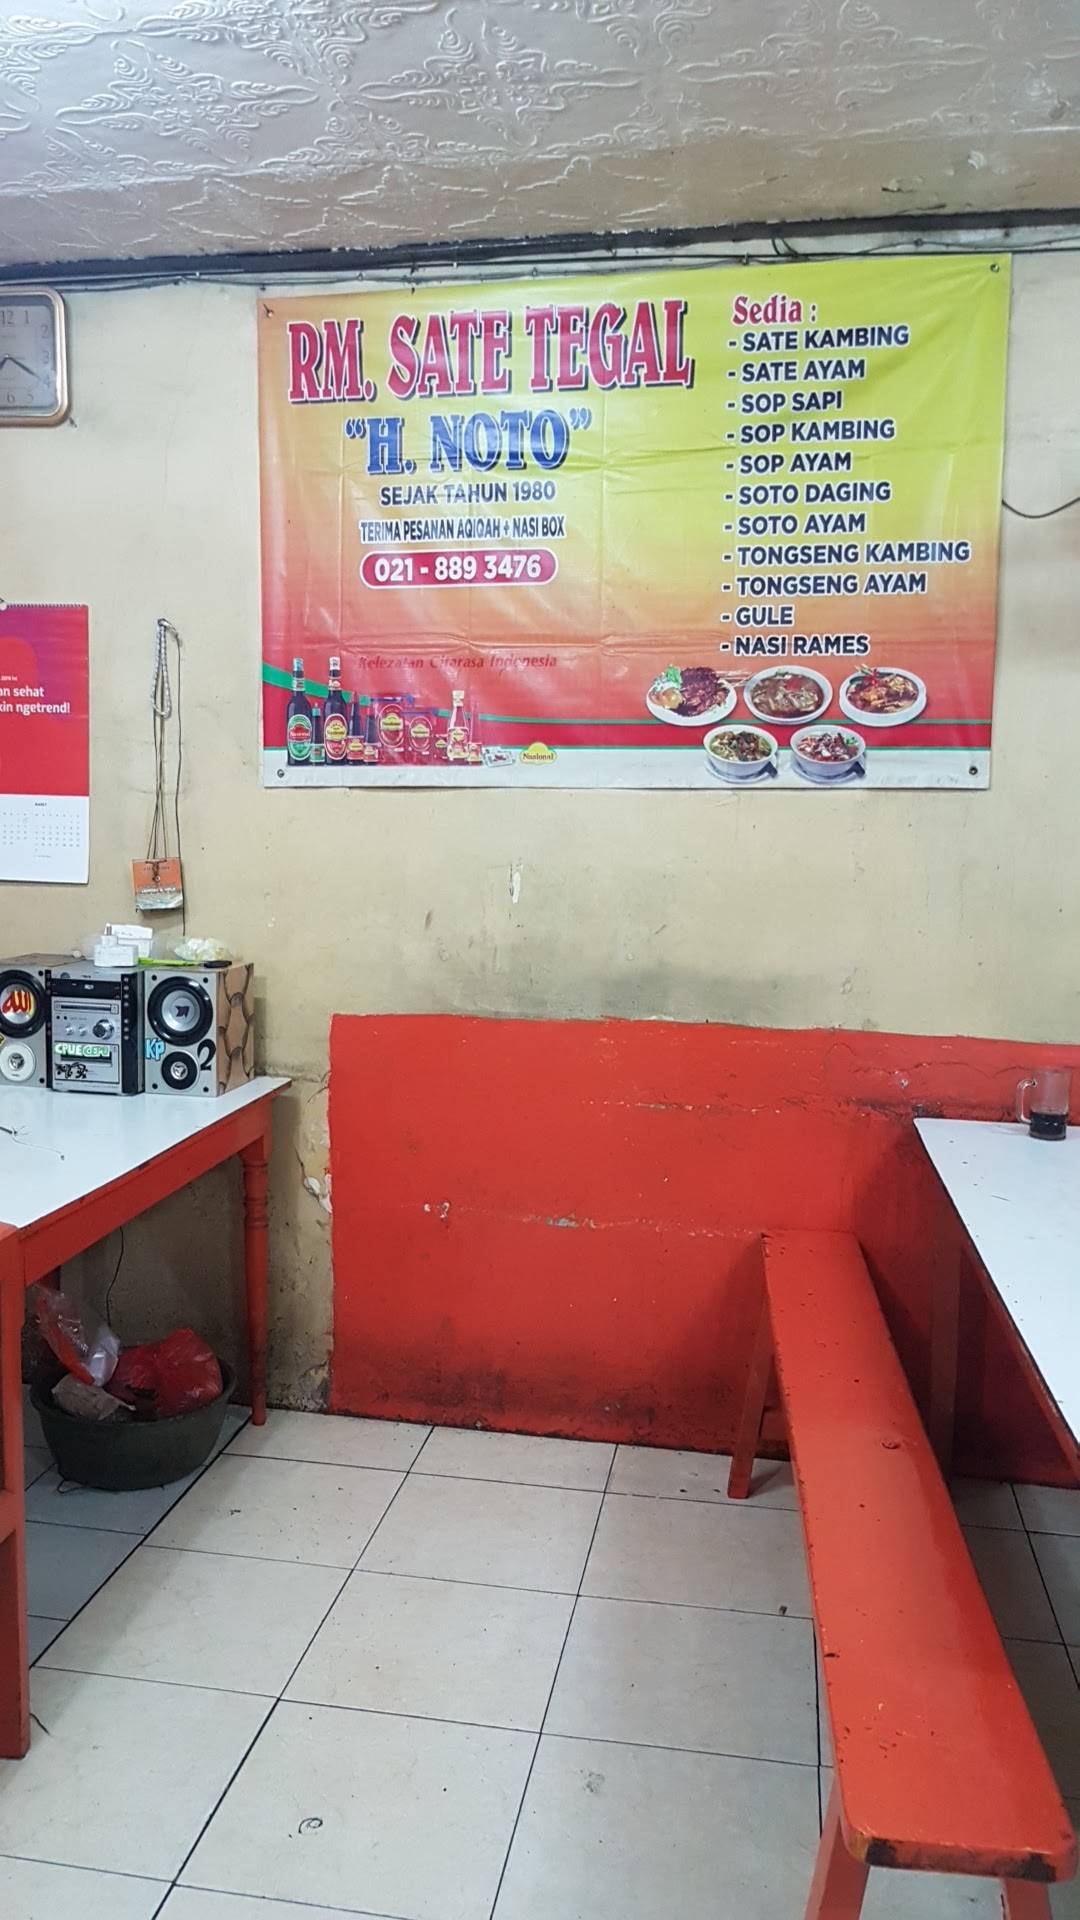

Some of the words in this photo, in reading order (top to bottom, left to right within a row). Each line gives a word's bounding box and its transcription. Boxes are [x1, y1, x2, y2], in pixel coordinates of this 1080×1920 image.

[733, 295, 802, 324] Sedia
[742, 332, 798, 352] SATE
[804, 326, 909, 349] KAMBING
[287, 319, 377, 406] RM.
[386, 310, 512, 400] SATE
[525, 298, 696, 390] TEGAL
[742, 362, 797, 382] SATE
[803, 359, 865, 379] AYAM
[742, 394, 785, 413] SOP
[791, 391, 842, 411] SAPI
[741, 425, 785, 444] SOP
[791, 419, 895, 441] KAMBING
[740, 455, 784, 473] SOP
[790, 452, 851, 472] AYAM
[380, 483, 438, 507] SEJAK
[443, 482, 508, 504] TAHUN
[512, 480, 556, 502] 1980
[739, 485, 798, 505] SOTO
[805, 482, 890, 502] DAGING
[360, 521, 401, 543] TERIMA
[404, 518, 454, 542] PESANAN
[457, 518, 501, 540] AQIQAH
[513, 517, 539, 539] NASI
[541, 515, 565, 538] BOX
[738, 516, 798, 535] SOTO
[804, 514, 865, 533] AYAM
[737, 544, 858, 565] TONGSENG
[866, 541, 970, 562] KAMBING
[374, 559, 413, 582] 021
[434, 557, 476, 581] 889
[483, 555, 542, 579] 3476
[737, 574, 858, 595] TONGSENG
[864, 573, 926, 593] AYAM
[736, 607, 793, 625] GULE
[735, 636, 787, 655] NASI
[793, 635, 869, 654] RAMES
[13, 685, 44, 697] sehat
[16, 701, 70, 716] ngetrend!
